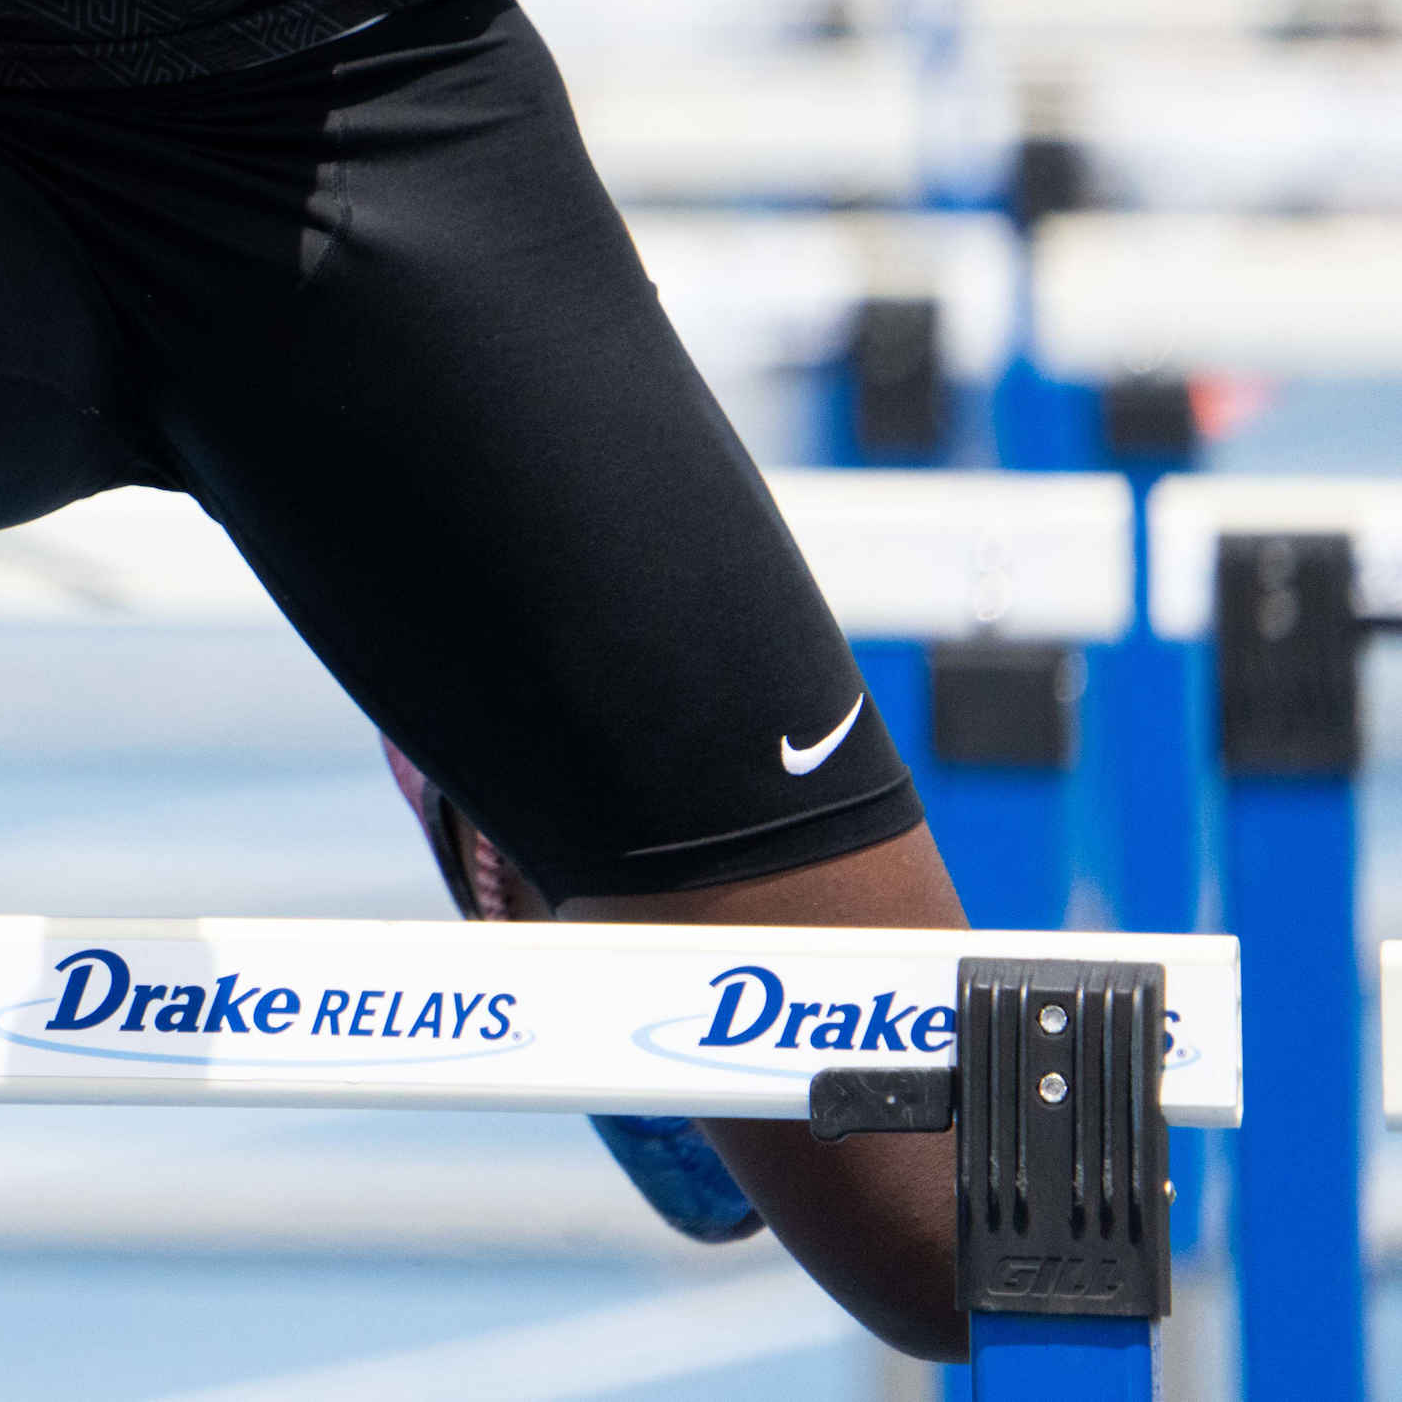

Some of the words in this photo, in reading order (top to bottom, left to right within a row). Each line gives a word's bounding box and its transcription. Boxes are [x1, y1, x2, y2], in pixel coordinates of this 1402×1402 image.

[45, 948, 302, 1035] Drake
[311, 989, 516, 1041] RELAYS
[699, 965, 957, 1052] Drake
[986, 1254, 1125, 1303] GILL
